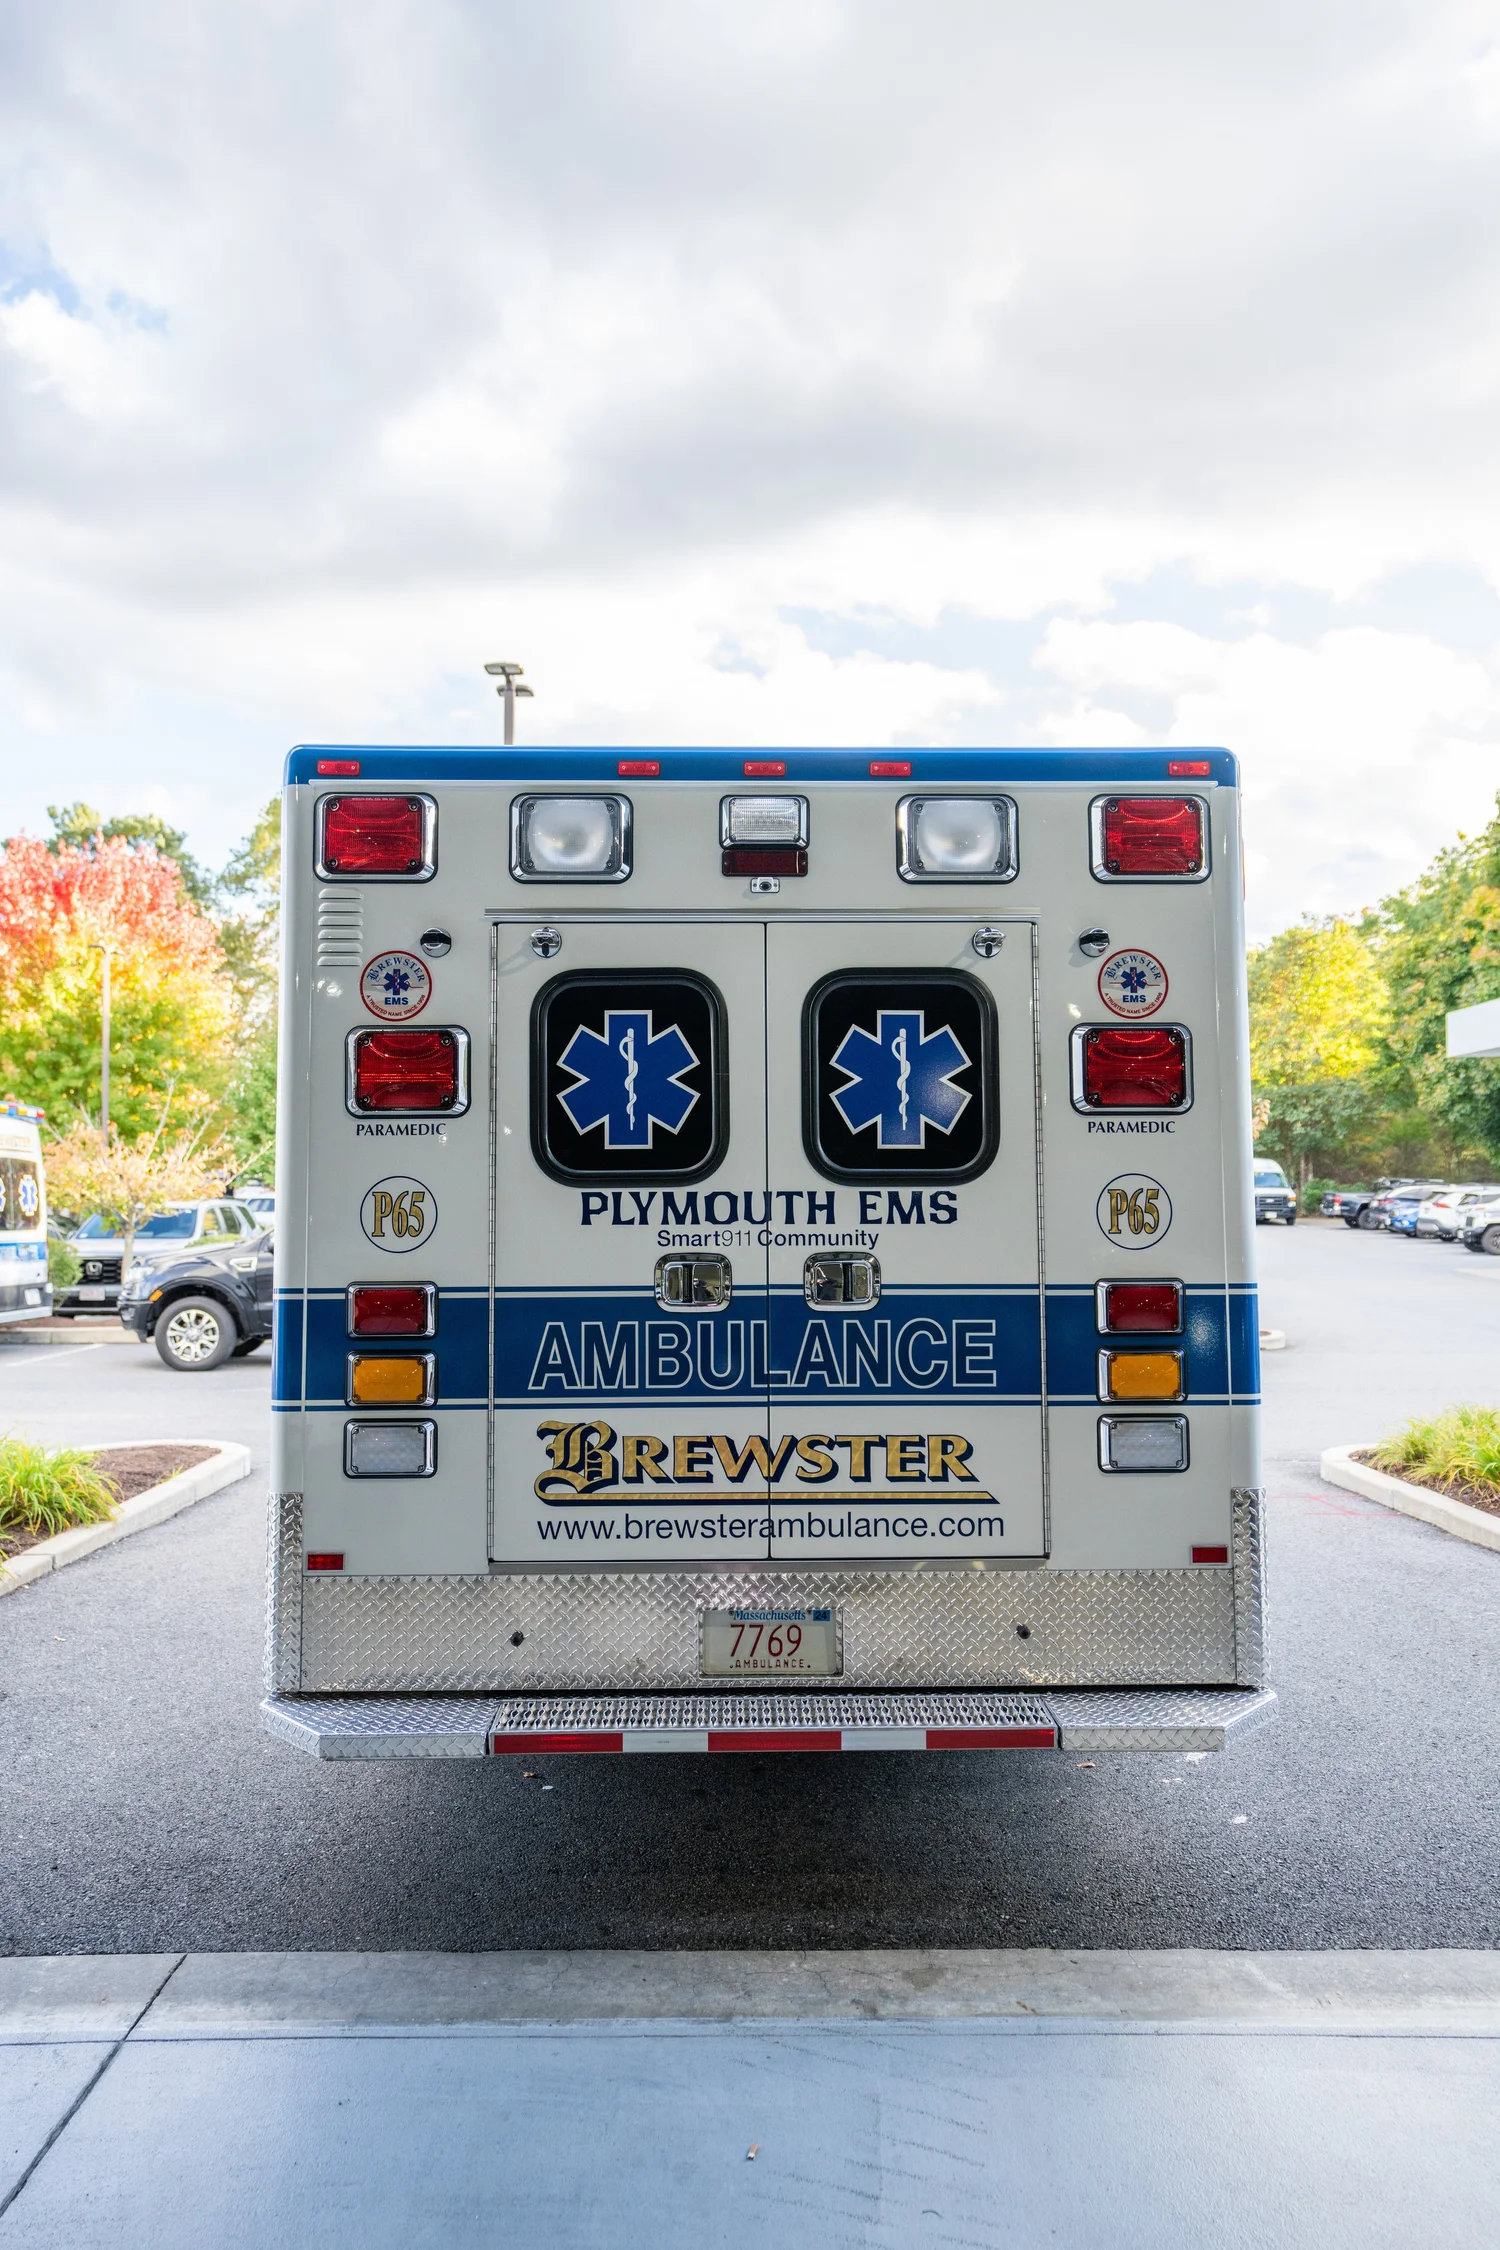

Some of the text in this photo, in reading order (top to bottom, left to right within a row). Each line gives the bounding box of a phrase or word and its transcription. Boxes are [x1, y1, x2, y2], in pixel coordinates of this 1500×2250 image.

[367, 957, 426, 982] BREWSTER
[1104, 955, 1161, 980] BREWSTER
[369, 998, 387, 1015] TRUSTED
[404, 1005, 418, 1015] SINCE
[384, 997, 409, 1005] EMS
[1107, 995, 1126, 1013] TRUSTED
[1142, 1003, 1156, 1012] SINCE
[1122, 994, 1146, 1003] EMS
[356, 1123, 447, 1136] PARAMEDIC
[1087, 1121, 1176, 1133] PARAMEDIC
[371, 1190, 425, 1238] P65
[580, 1190, 958, 1226] PLYMOUTH EMS
[1107, 1187, 1160, 1235] P65
[657, 1229, 879, 1250] Smart911 Community
[527, 1317, 997, 1390] AMBULANCE
[534, 1420, 980, 1502] BREWSTER
[537, 1512, 1005, 1540] www.brewsterambulance.com
[733, 1610, 827, 1621] Massachusetts 24
[730, 1624, 802, 1657] 7769
[735, 1659, 805, 1669] AMBULANCE
